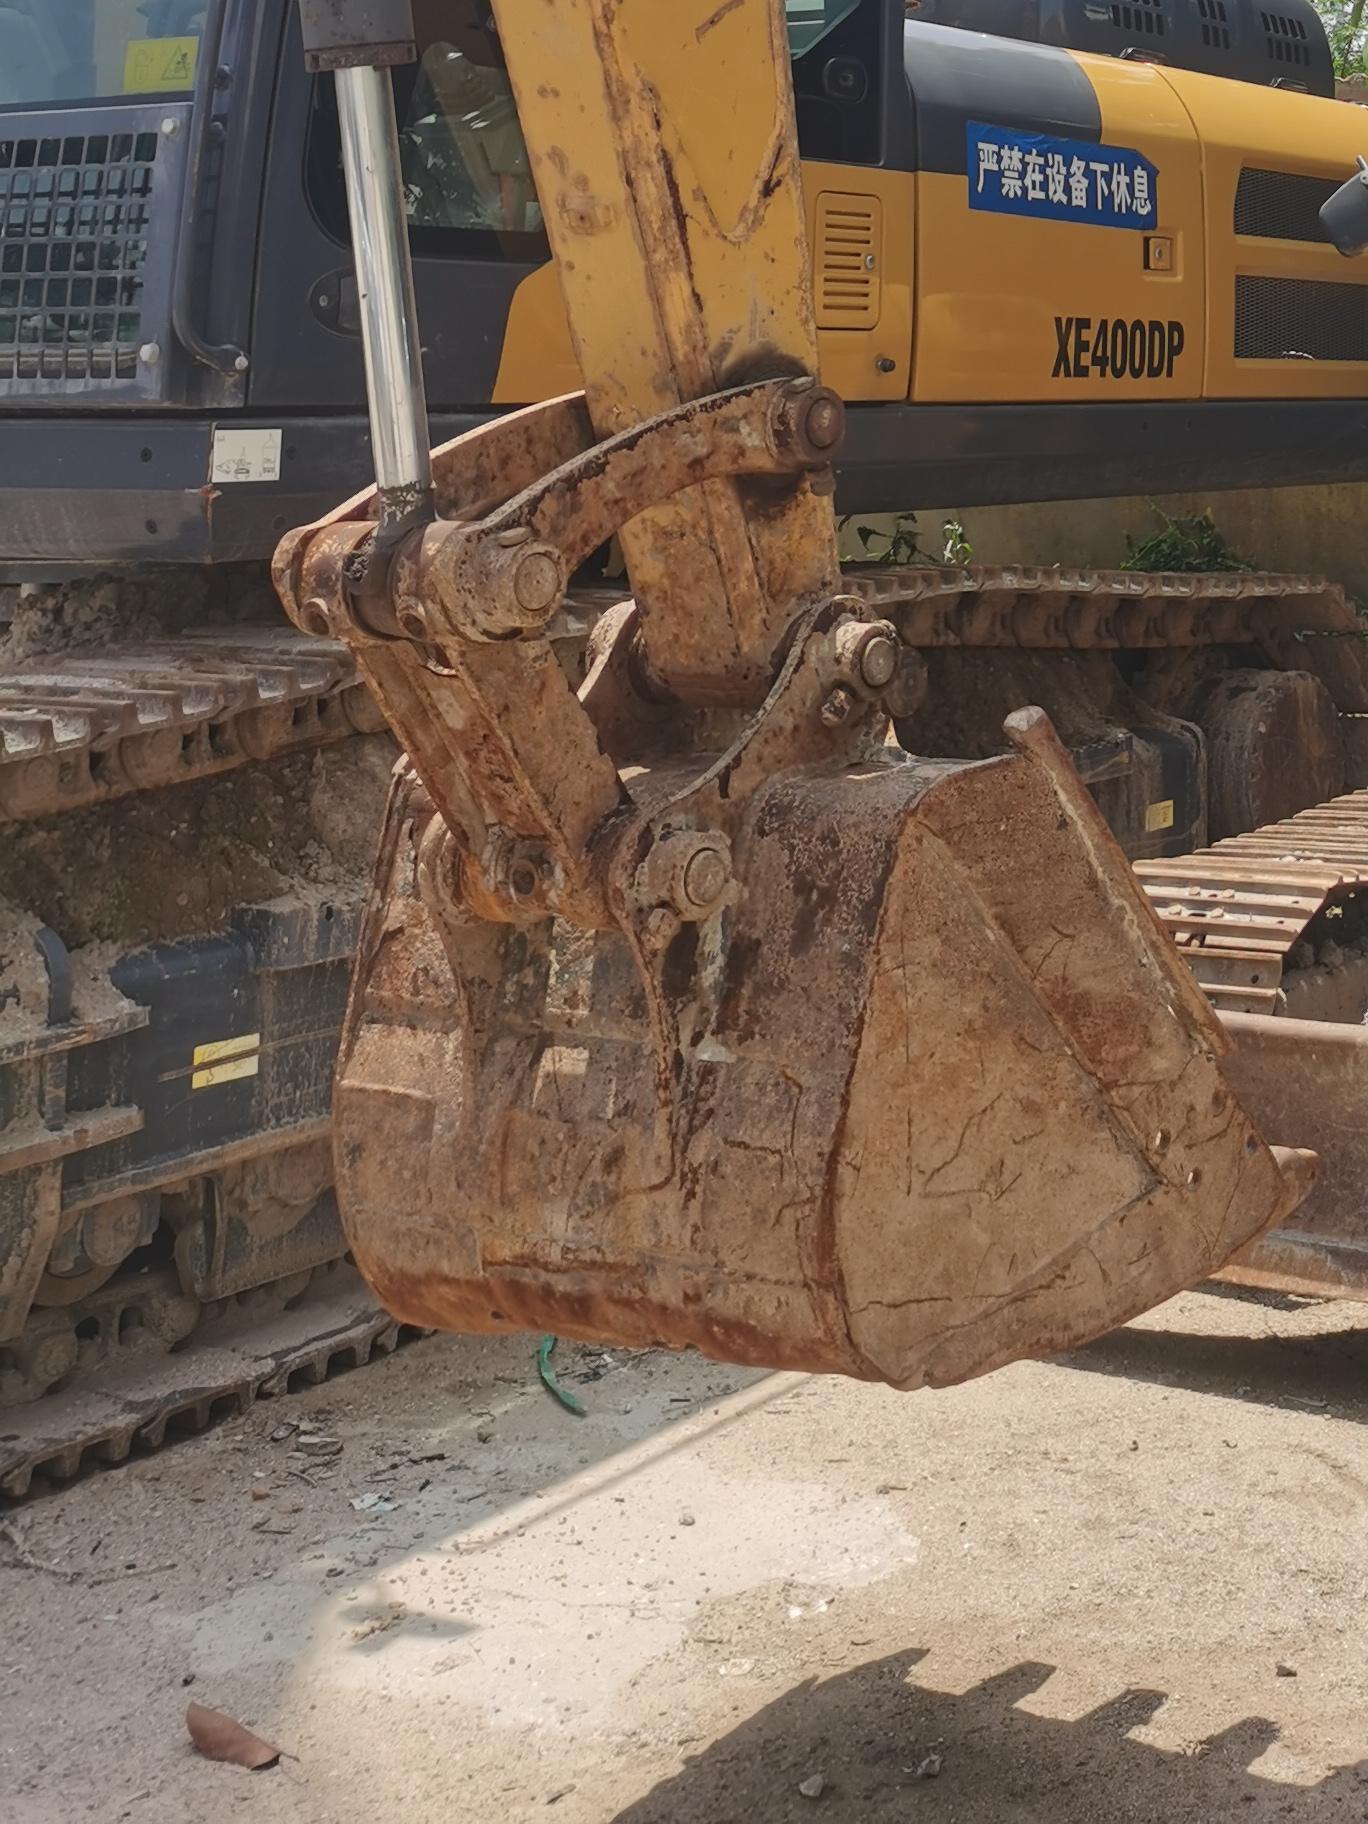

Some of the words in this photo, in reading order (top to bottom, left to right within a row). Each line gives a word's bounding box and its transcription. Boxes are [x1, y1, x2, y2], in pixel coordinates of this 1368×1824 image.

[976, 142, 1153, 216] 严禁在设备下休息
[1051, 316, 1184, 380] XE400DP
